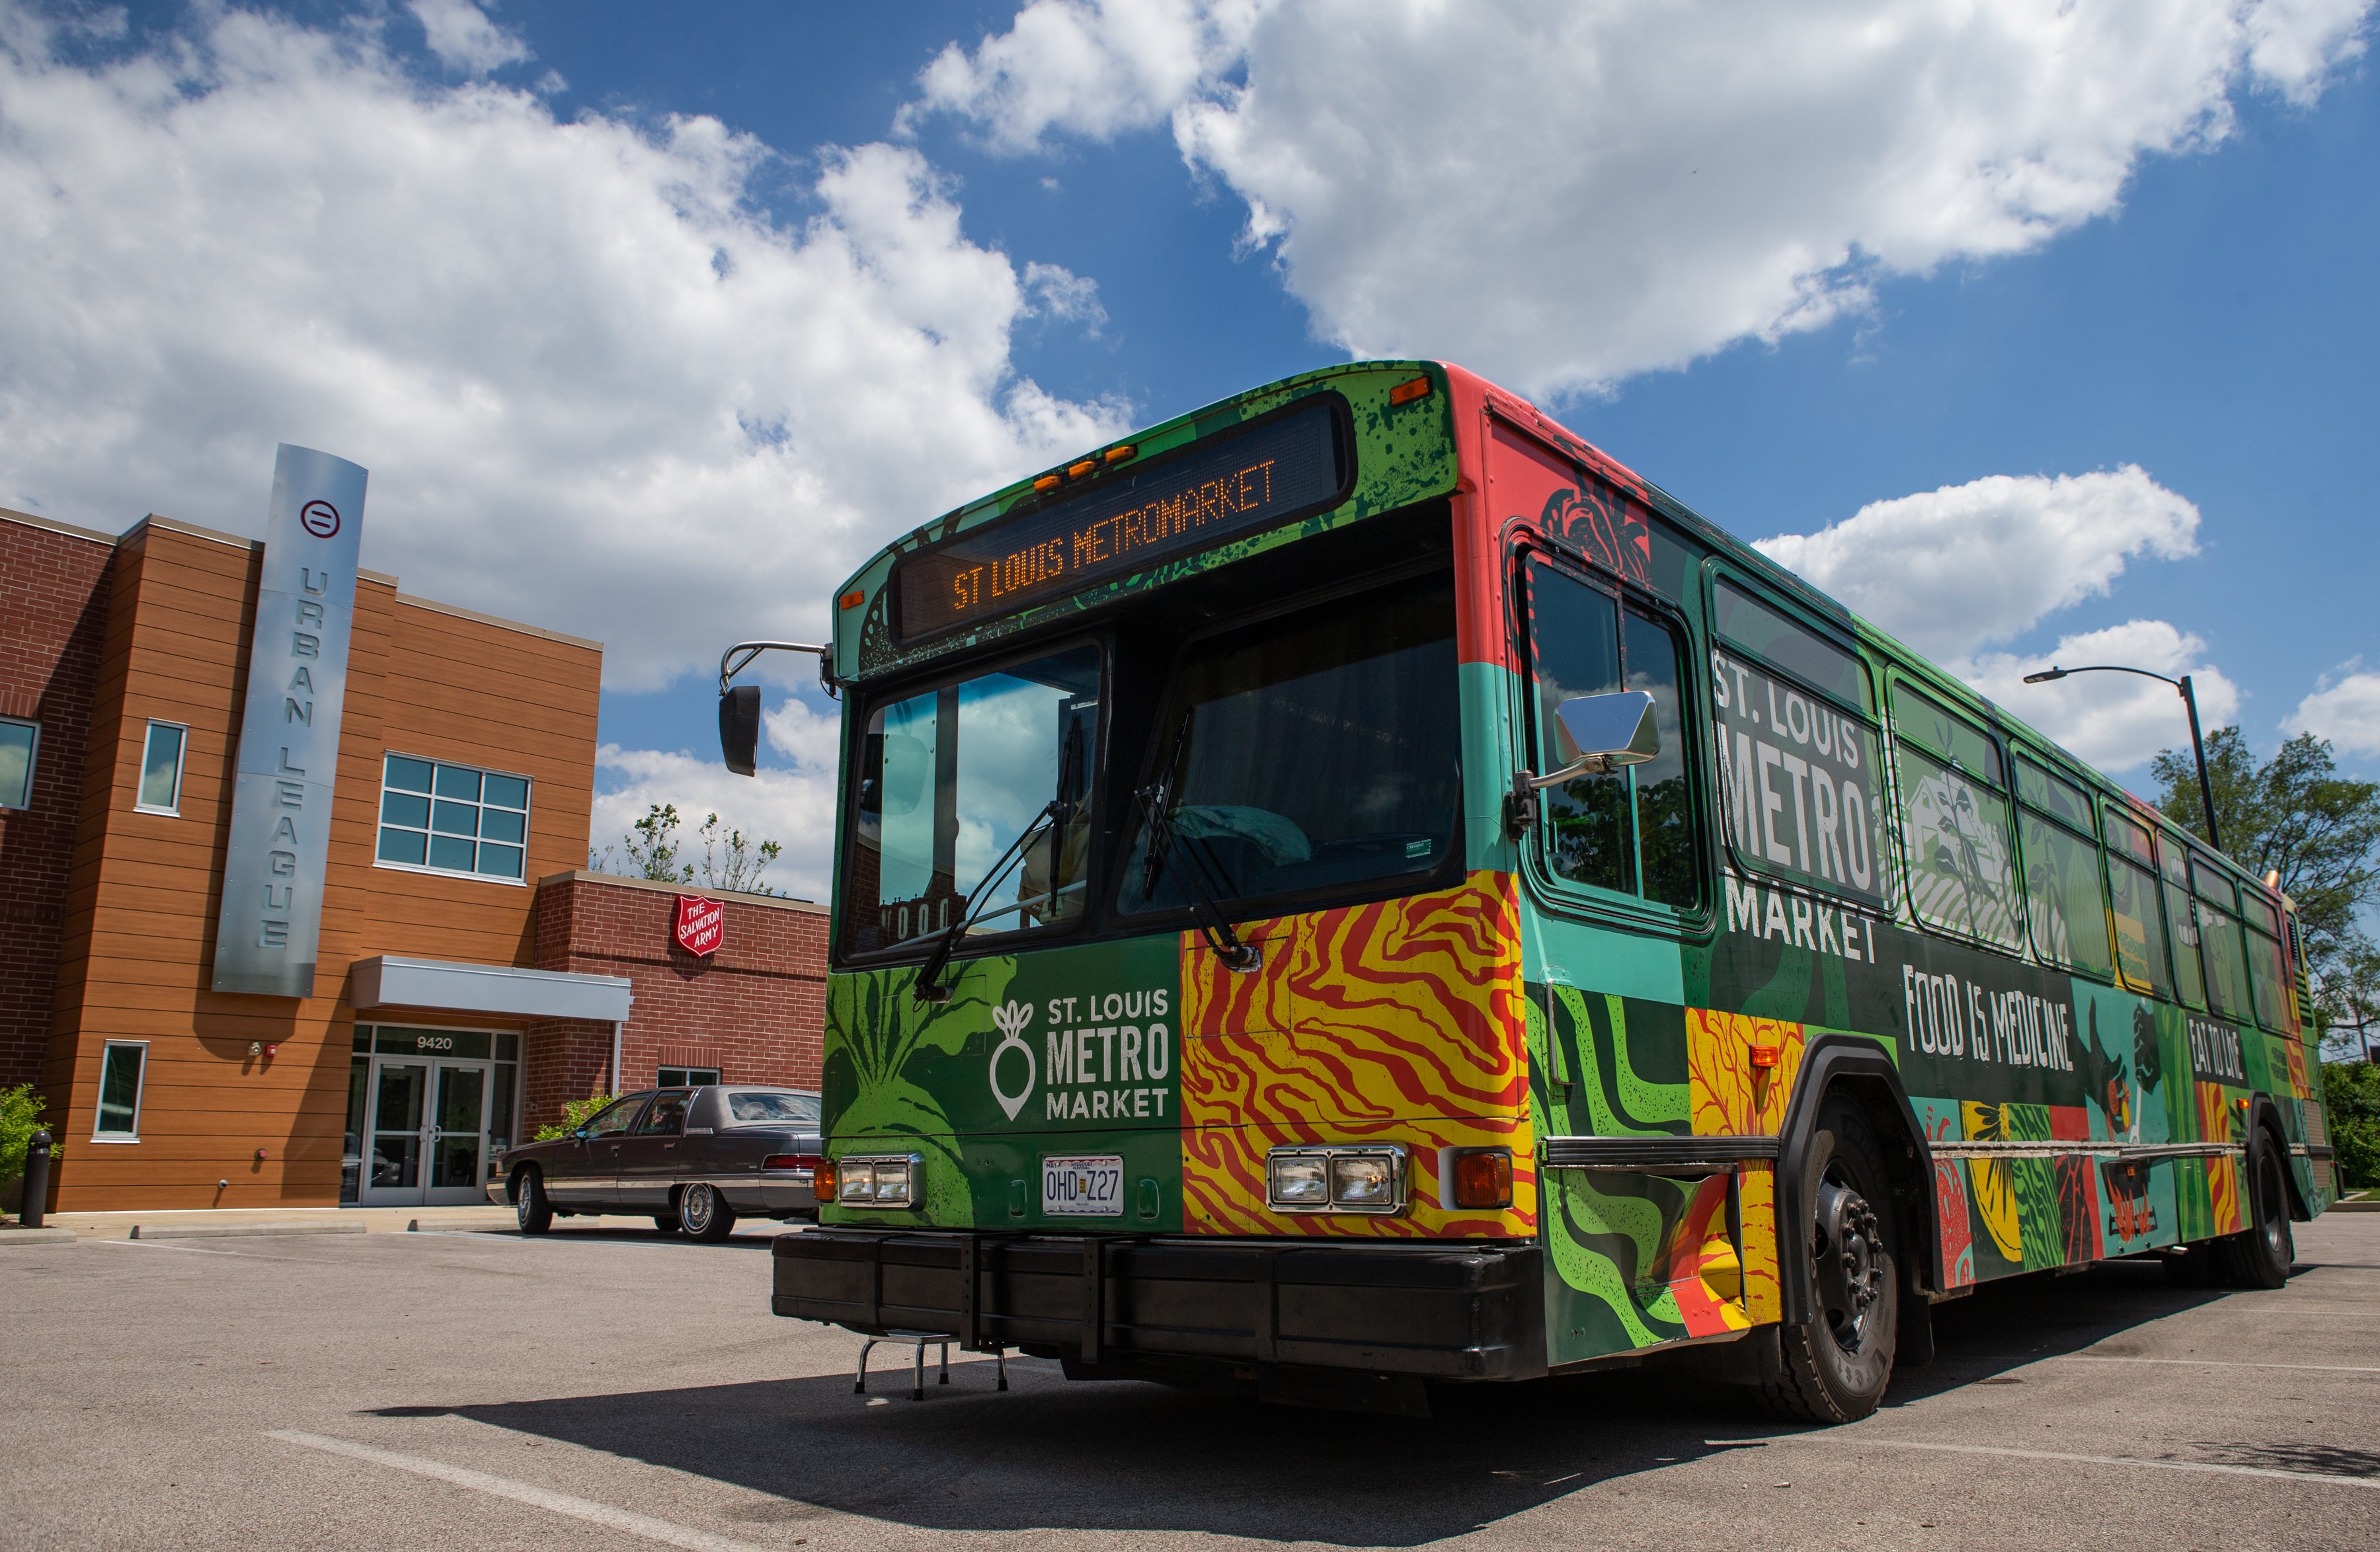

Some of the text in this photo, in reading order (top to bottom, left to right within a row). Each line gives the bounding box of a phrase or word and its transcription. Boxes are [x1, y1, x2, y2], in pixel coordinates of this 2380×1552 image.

[954, 459, 1275, 610] ST LOUIS METROMARKET
[1711, 648, 1860, 769] ST. LOUIS
[257, 566, 328, 950] URBAN LEAGUE
[1711, 720, 1872, 891] METRO
[680, 907, 720, 940] SALVATION
[687, 902, 705, 920] THE
[694, 923, 719, 948] ARMY
[1723, 865, 1878, 964] MARKET
[1048, 988, 1169, 1025] ST. LOUIS
[1902, 963, 2075, 1072] FOOD IS MEDICINE
[417, 1036, 452, 1050] 9420
[1047, 1023, 1169, 1085] METRO
[2188, 1019, 2212, 1074] EAT
[2207, 1023, 2224, 1076] TO
[1047, 1087, 1169, 1120] MARKET
[1086, 1169, 1119, 1201] Z27
